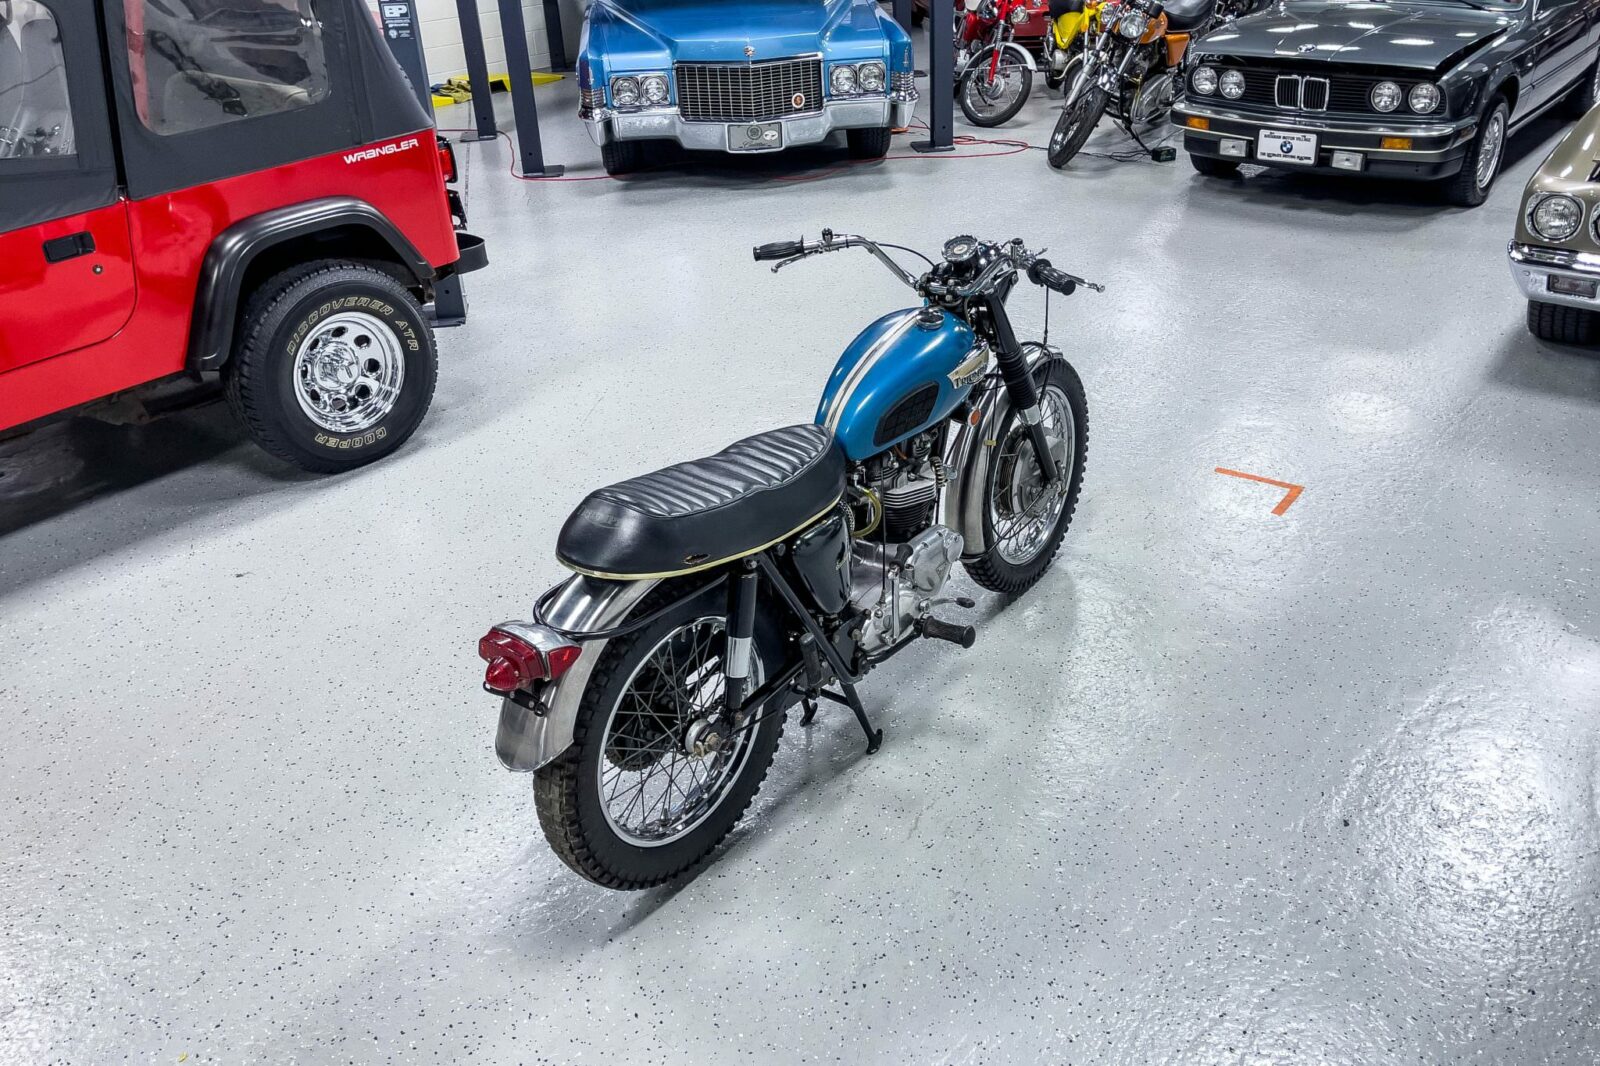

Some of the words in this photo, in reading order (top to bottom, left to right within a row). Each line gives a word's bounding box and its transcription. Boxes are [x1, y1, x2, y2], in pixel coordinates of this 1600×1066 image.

[383, 5, 407, 18] BP
[344, 139, 419, 164] WRANGLER
[286, 296, 394, 356] DISCOVERER
[395, 319, 419, 351] ATR
[314, 427, 387, 449] COOPER
